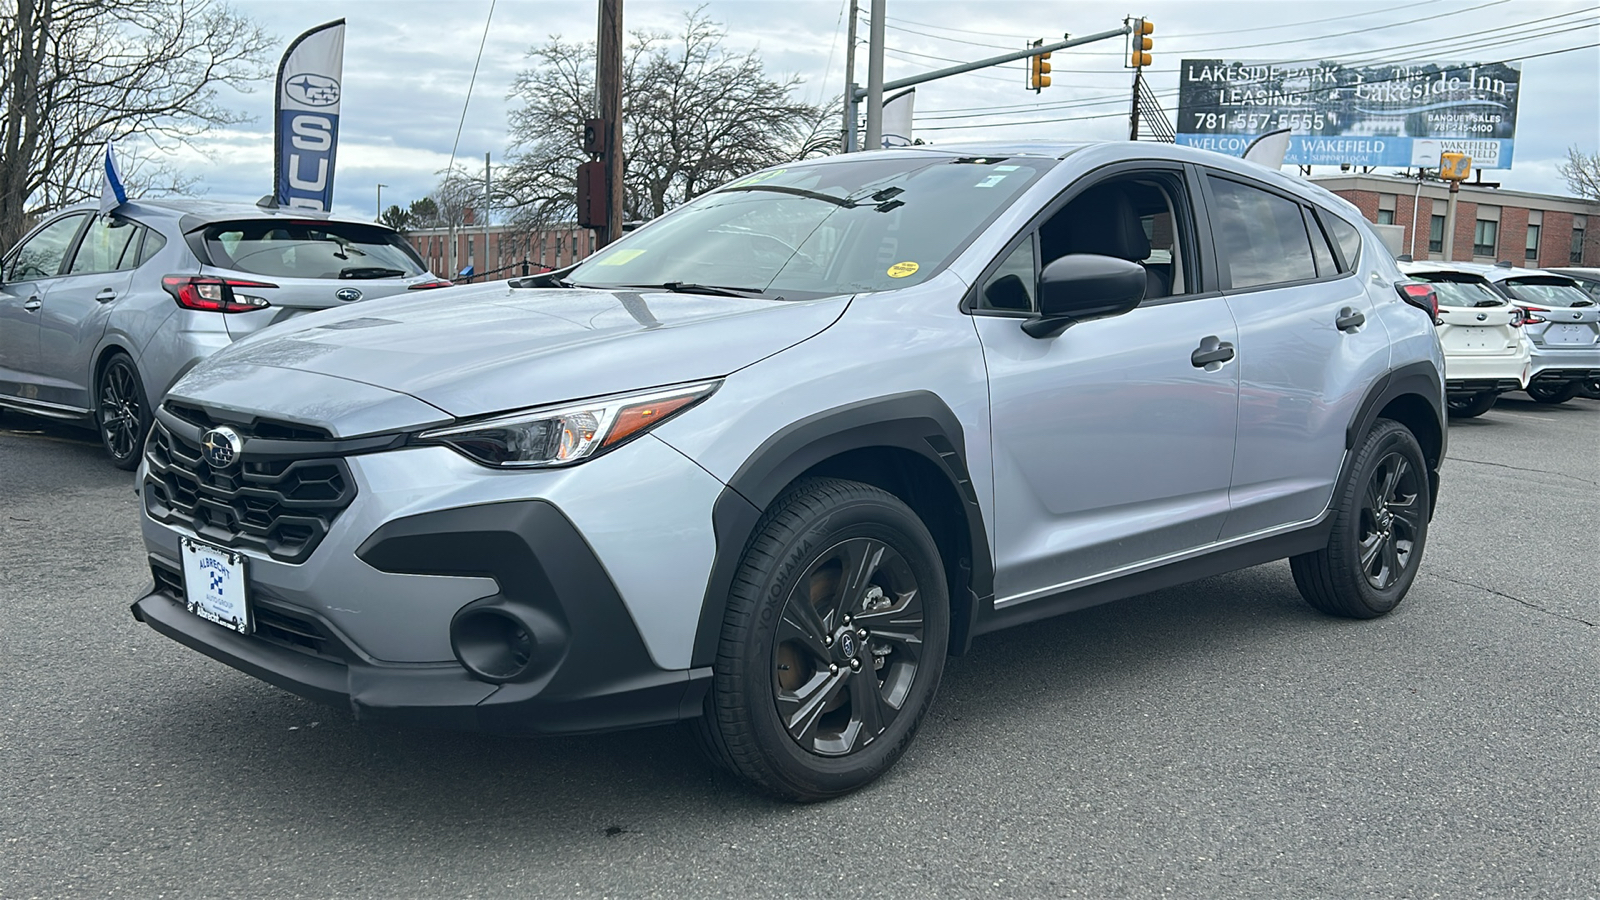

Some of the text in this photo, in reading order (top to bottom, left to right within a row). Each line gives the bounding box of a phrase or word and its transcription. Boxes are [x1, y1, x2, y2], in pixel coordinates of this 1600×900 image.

[1189, 65, 1338, 83] LAKESIDE PARK
[1391, 67, 1424, 84] The
[1354, 66, 1507, 102] Lakeside Inn
[1220, 89, 1302, 106] LEASING
[1195, 113, 1325, 130] 781-557-5555
[1428, 114, 1502, 123] BANQUET SALES
[1434, 124, 1494, 133] 781-245-6100
[1301, 139, 1386, 153] WAKEFIELD
[1440, 141, 1499, 150] WAKEFIELD
[200, 557, 230, 580] ALBRECHT
[758, 540, 813, 631] YOKOHAMA
